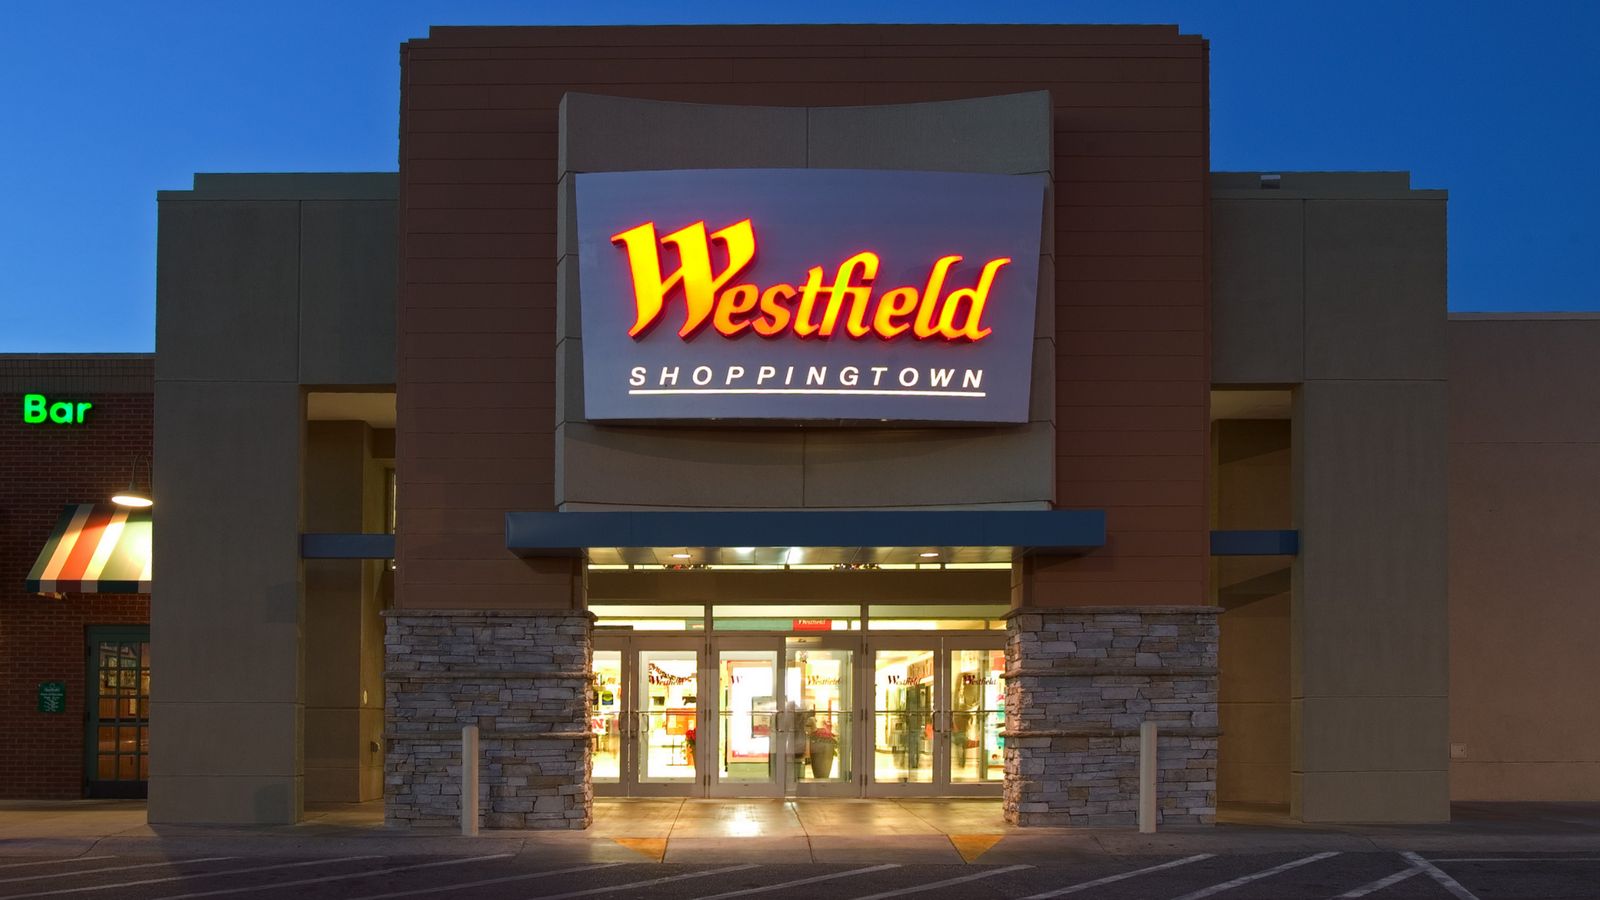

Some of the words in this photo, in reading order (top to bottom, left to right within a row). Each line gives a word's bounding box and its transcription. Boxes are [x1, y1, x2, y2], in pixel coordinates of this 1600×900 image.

[611, 218, 1012, 341] Westfield
[629, 366, 985, 389] SHOPPINGTOWN
[24, 394, 92, 424] Bar
